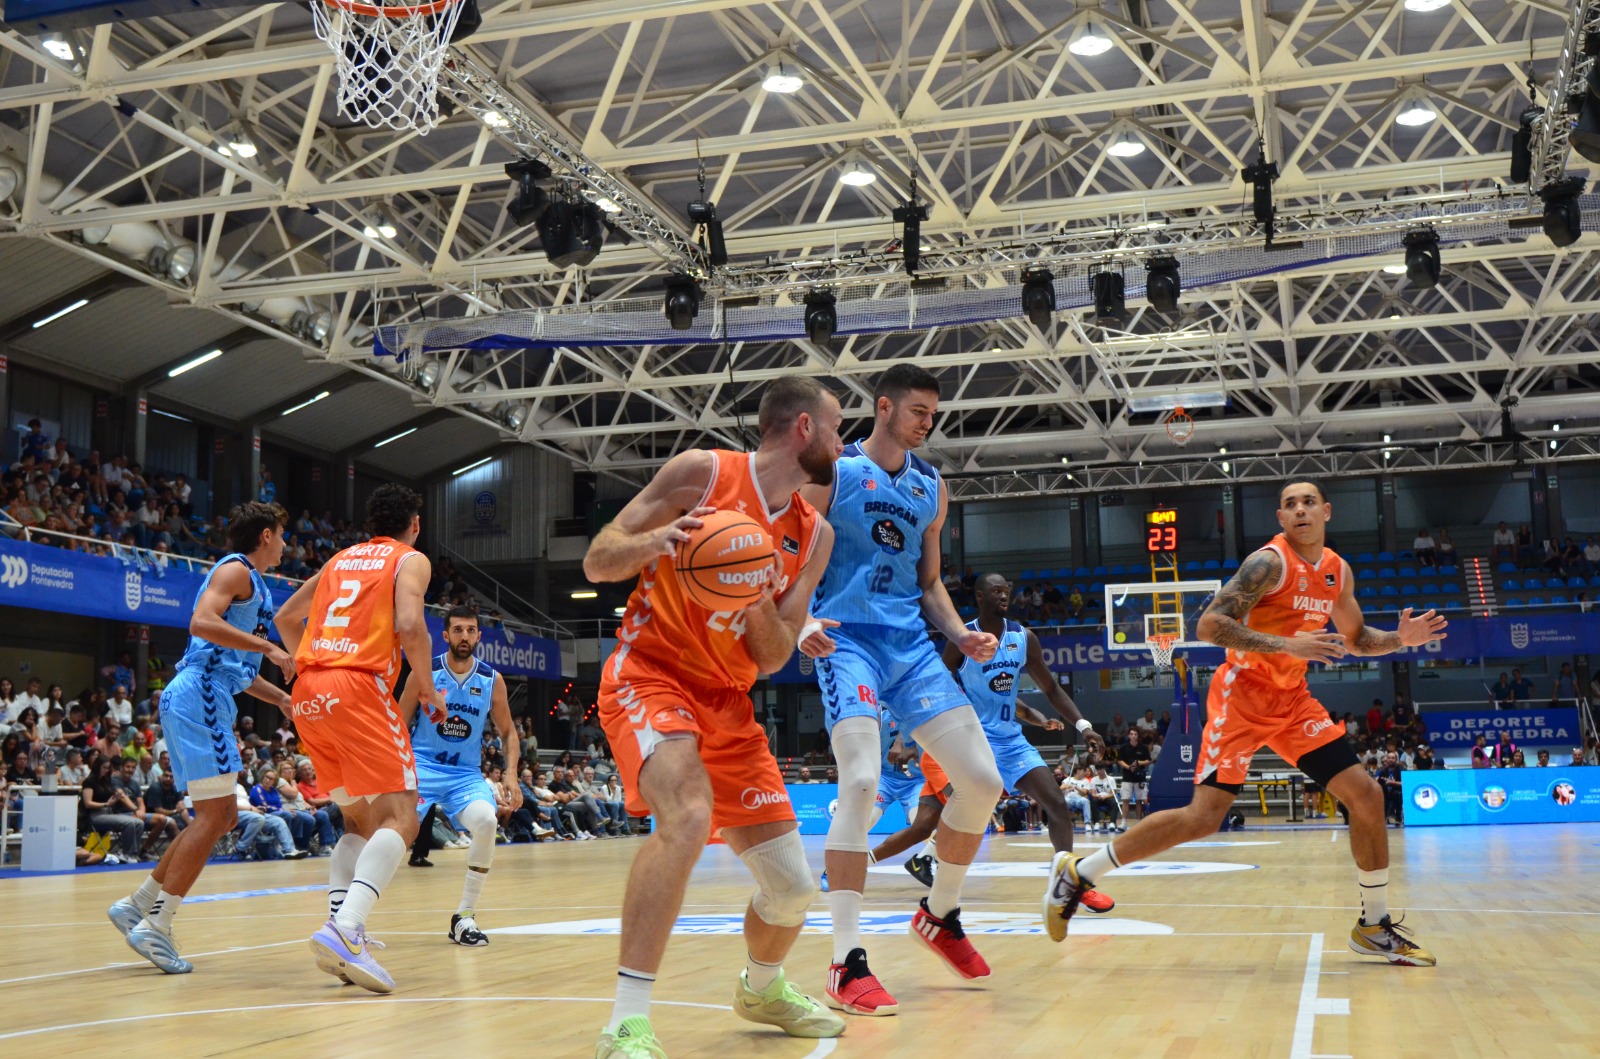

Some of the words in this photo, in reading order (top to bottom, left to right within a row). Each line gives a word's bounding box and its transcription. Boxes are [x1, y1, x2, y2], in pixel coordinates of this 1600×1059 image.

[863, 501, 919, 528] BREOGÁN
[1148, 527, 1176, 550] 23
[343, 544, 394, 557] PUERTO
[31, 563, 74, 579] Deputación
[334, 559, 386, 571] PAMESA
[31, 575, 74, 590] Pontevedra
[869, 564, 894, 594] 12
[143, 585, 167, 596] Concello
[151, 597, 180, 607] Pontevedra
[323, 579, 361, 628] 2
[476, 640, 546, 671] ontevedra
[292, 699, 320, 718] MGS
[446, 702, 480, 717] EOGÁN
[1001, 704, 1011, 722] 0
[443, 722, 467, 731] Estrella
[1450, 716, 1546, 729] DEPORTE
[443, 729, 466, 737] Galicia
[1429, 728, 1569, 742] PONTEEDRA
[435, 750, 461, 766] 44
